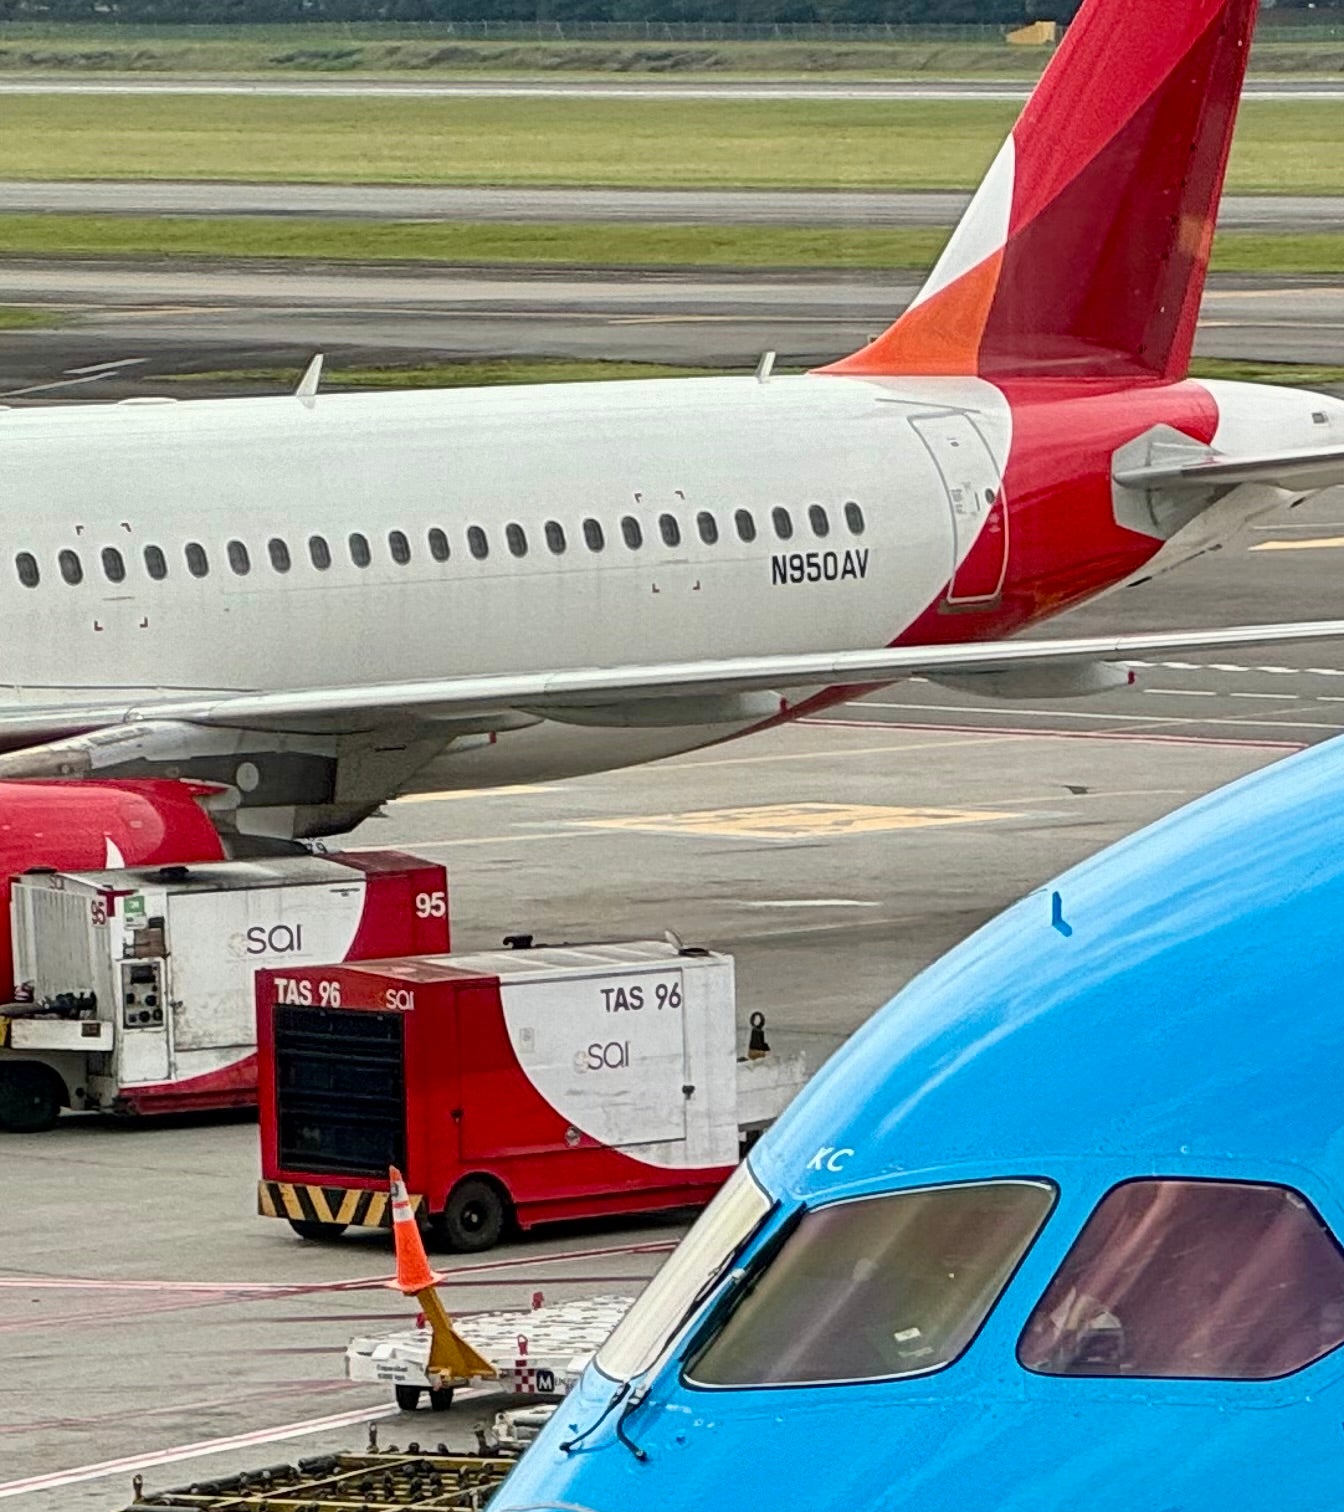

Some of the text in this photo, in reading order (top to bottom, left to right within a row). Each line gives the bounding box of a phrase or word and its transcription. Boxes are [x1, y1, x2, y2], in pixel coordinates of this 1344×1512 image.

[771, 548, 869, 585] N950AV
[90, 899, 107, 926] 95
[416, 892, 447, 918] 95
[274, 977, 341, 1008] TAS 96
[601, 982, 682, 1014] TAS 96
[806, 1147, 855, 1172] KC
